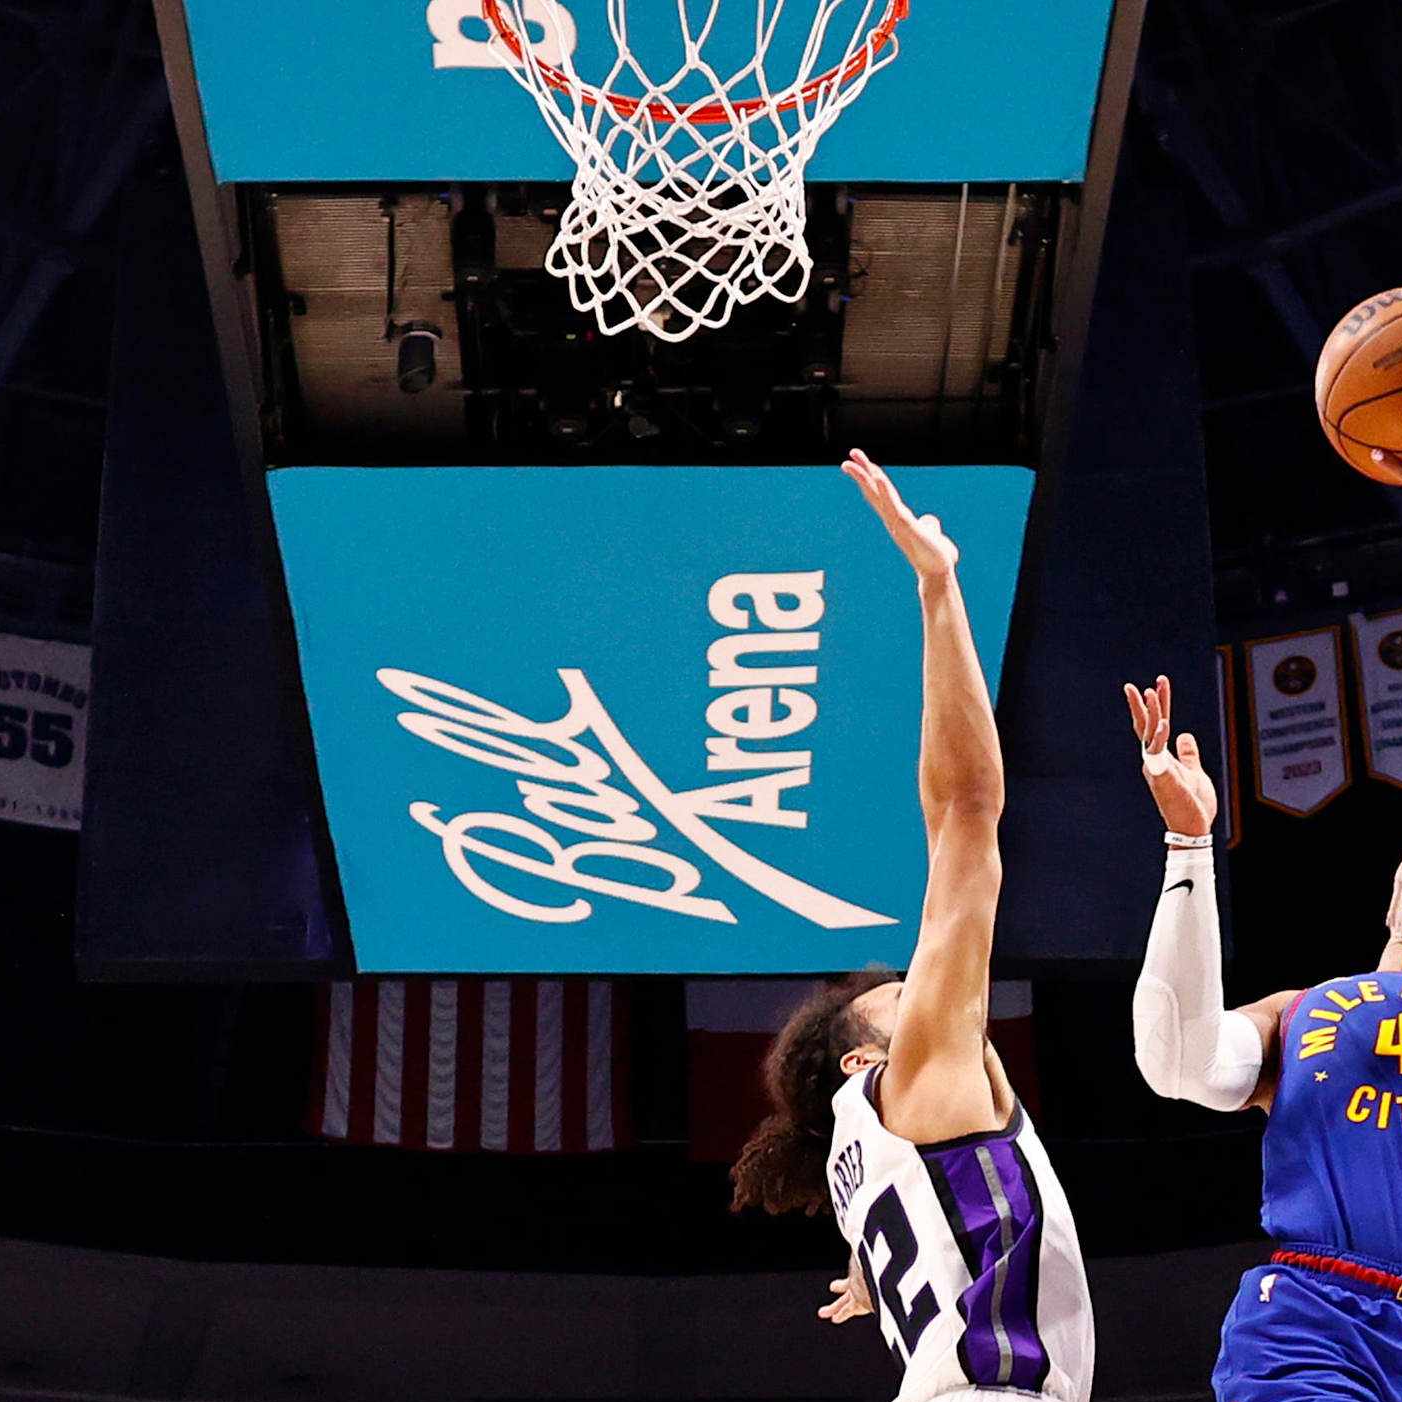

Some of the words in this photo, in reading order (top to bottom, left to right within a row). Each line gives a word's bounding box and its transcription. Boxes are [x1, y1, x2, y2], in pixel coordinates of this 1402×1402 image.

[377, 668, 899, 930] Ball
[705, 570, 825, 829] Arena
[1299, 981, 1385, 1060] MILE
